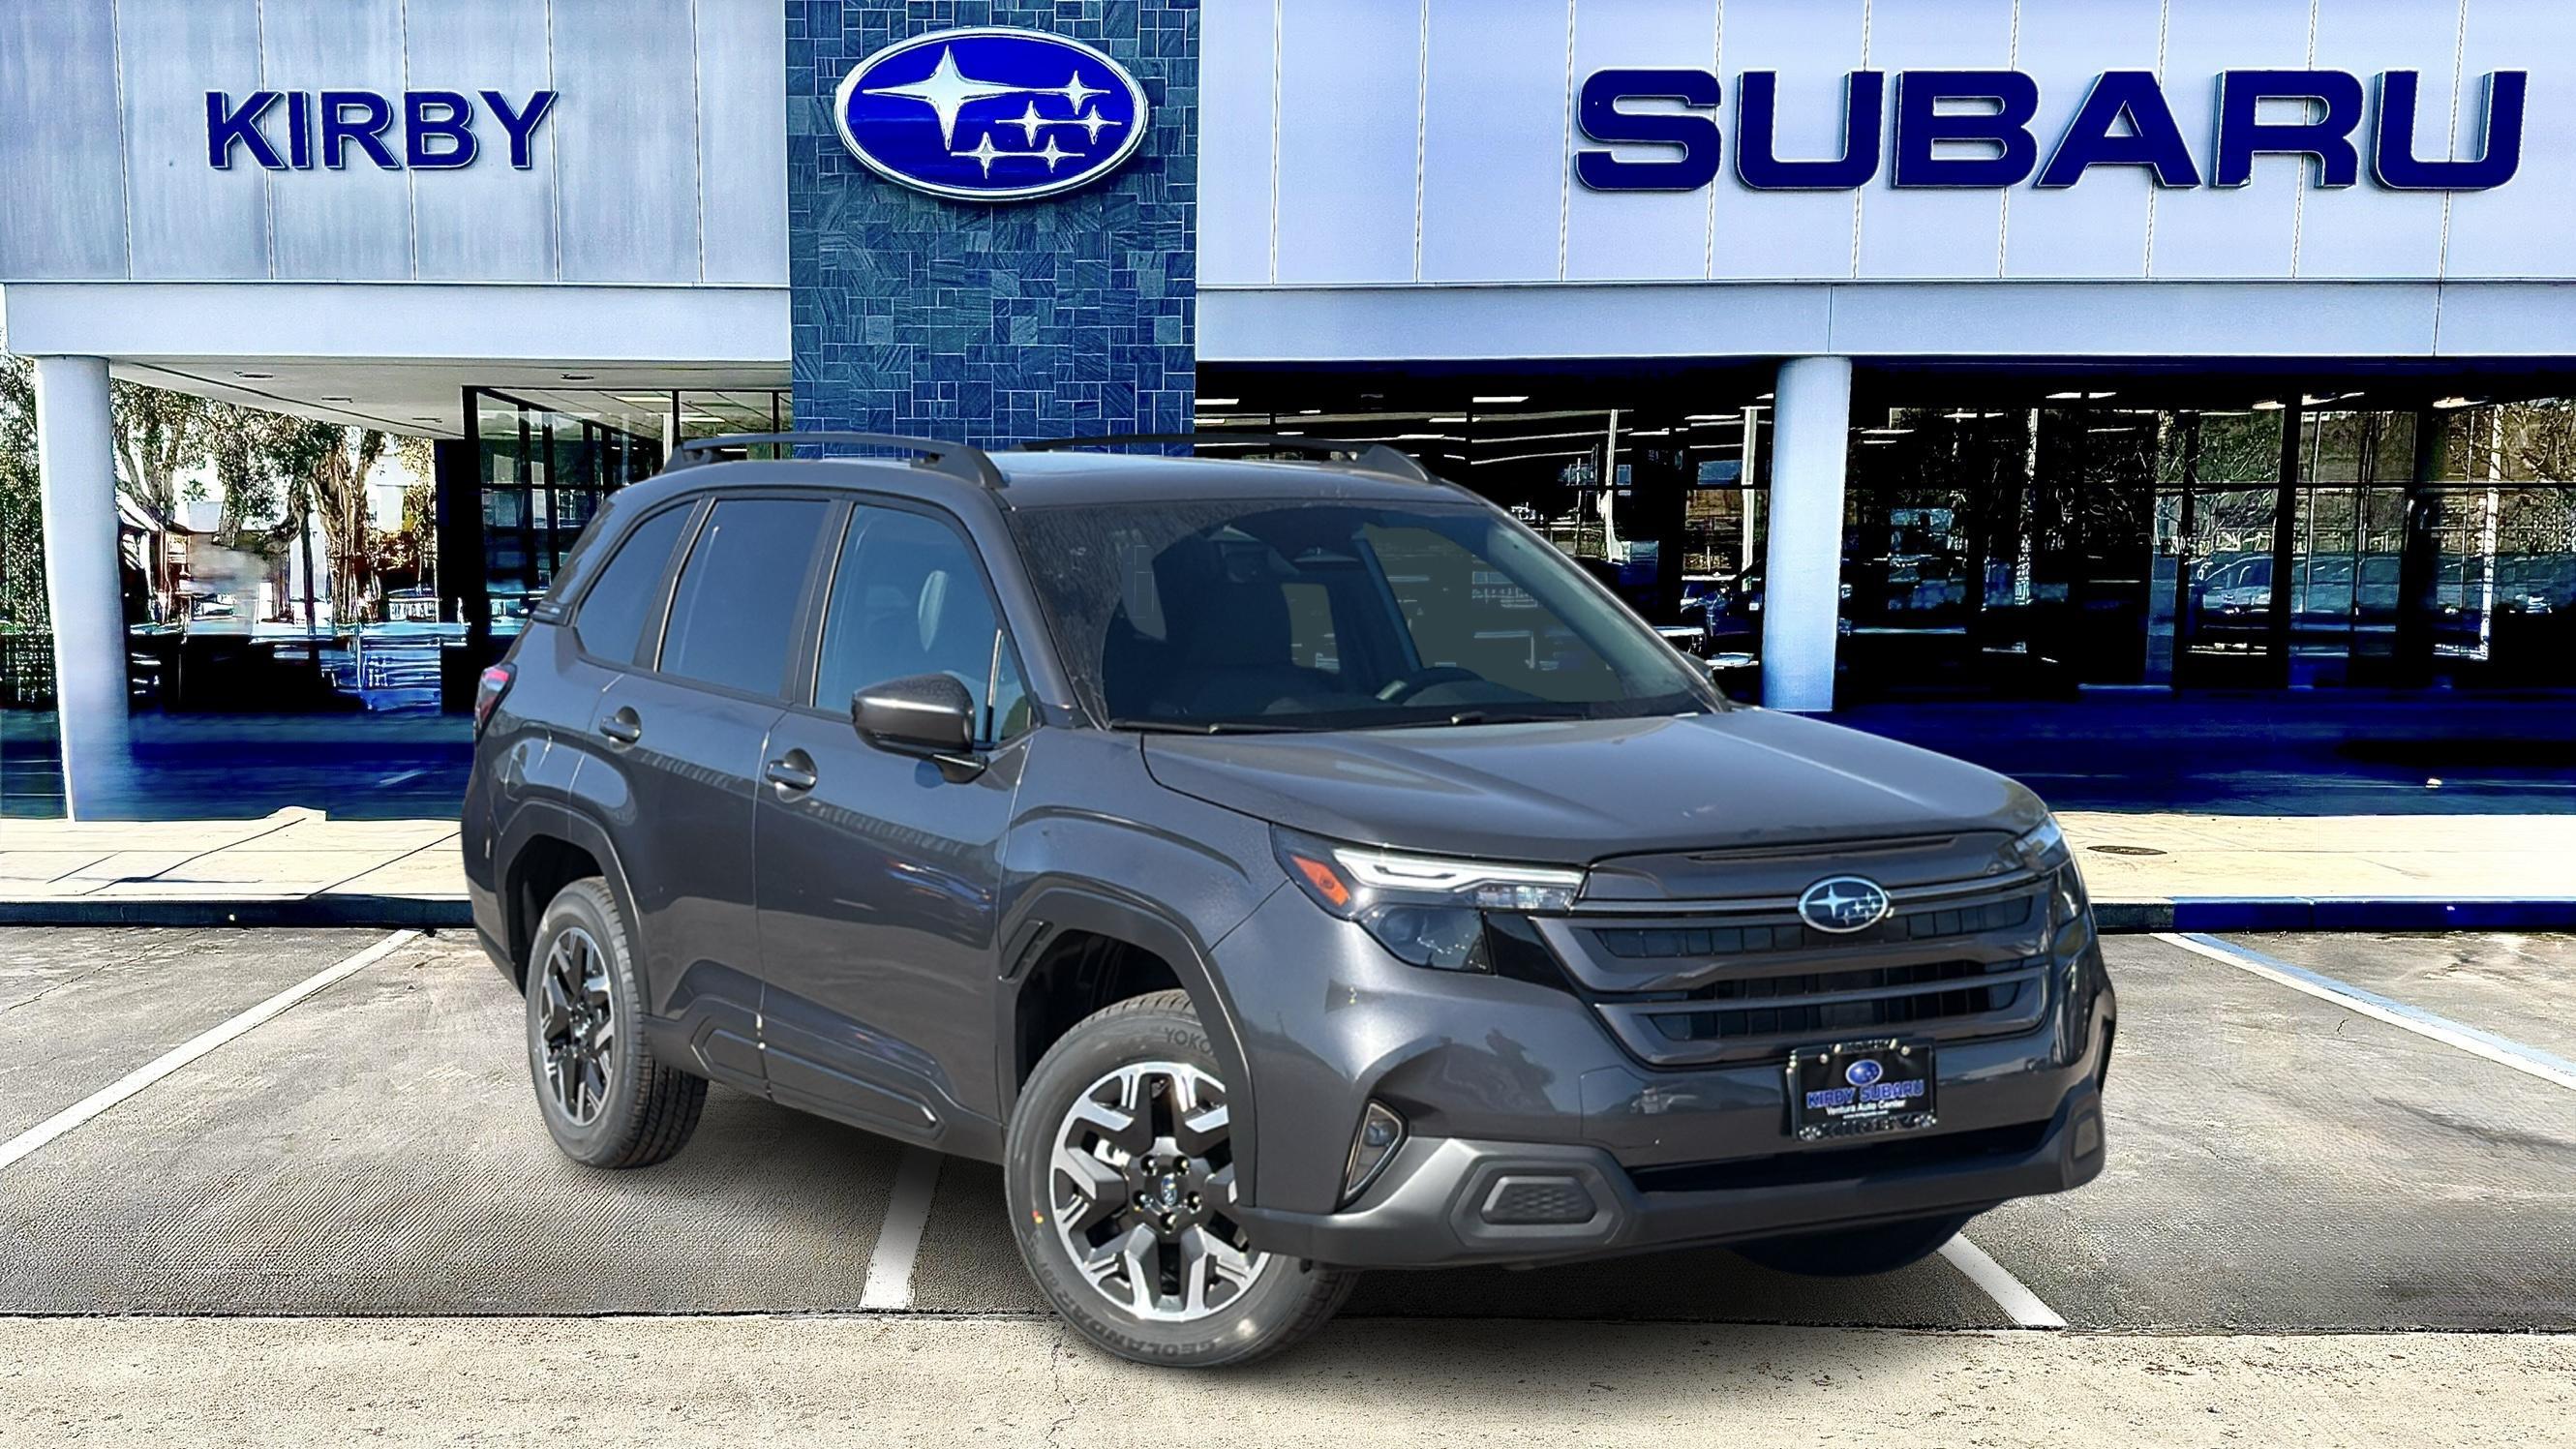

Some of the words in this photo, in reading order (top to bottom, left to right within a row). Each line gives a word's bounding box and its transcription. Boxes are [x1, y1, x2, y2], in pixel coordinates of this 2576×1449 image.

[205, 90, 559, 169] KIRBY
[1574, 69, 2530, 191] SUBARU
[1806, 1087, 1856, 1109] KIRBY
[1860, 1079, 1924, 1102] SUBARU
[1826, 1105, 1856, 1115] Ventura
[1858, 1102, 1876, 1111] Auto
[1878, 1100, 1906, 1109] Center
[1057, 1290, 1216, 1356] GEOLANDAR
